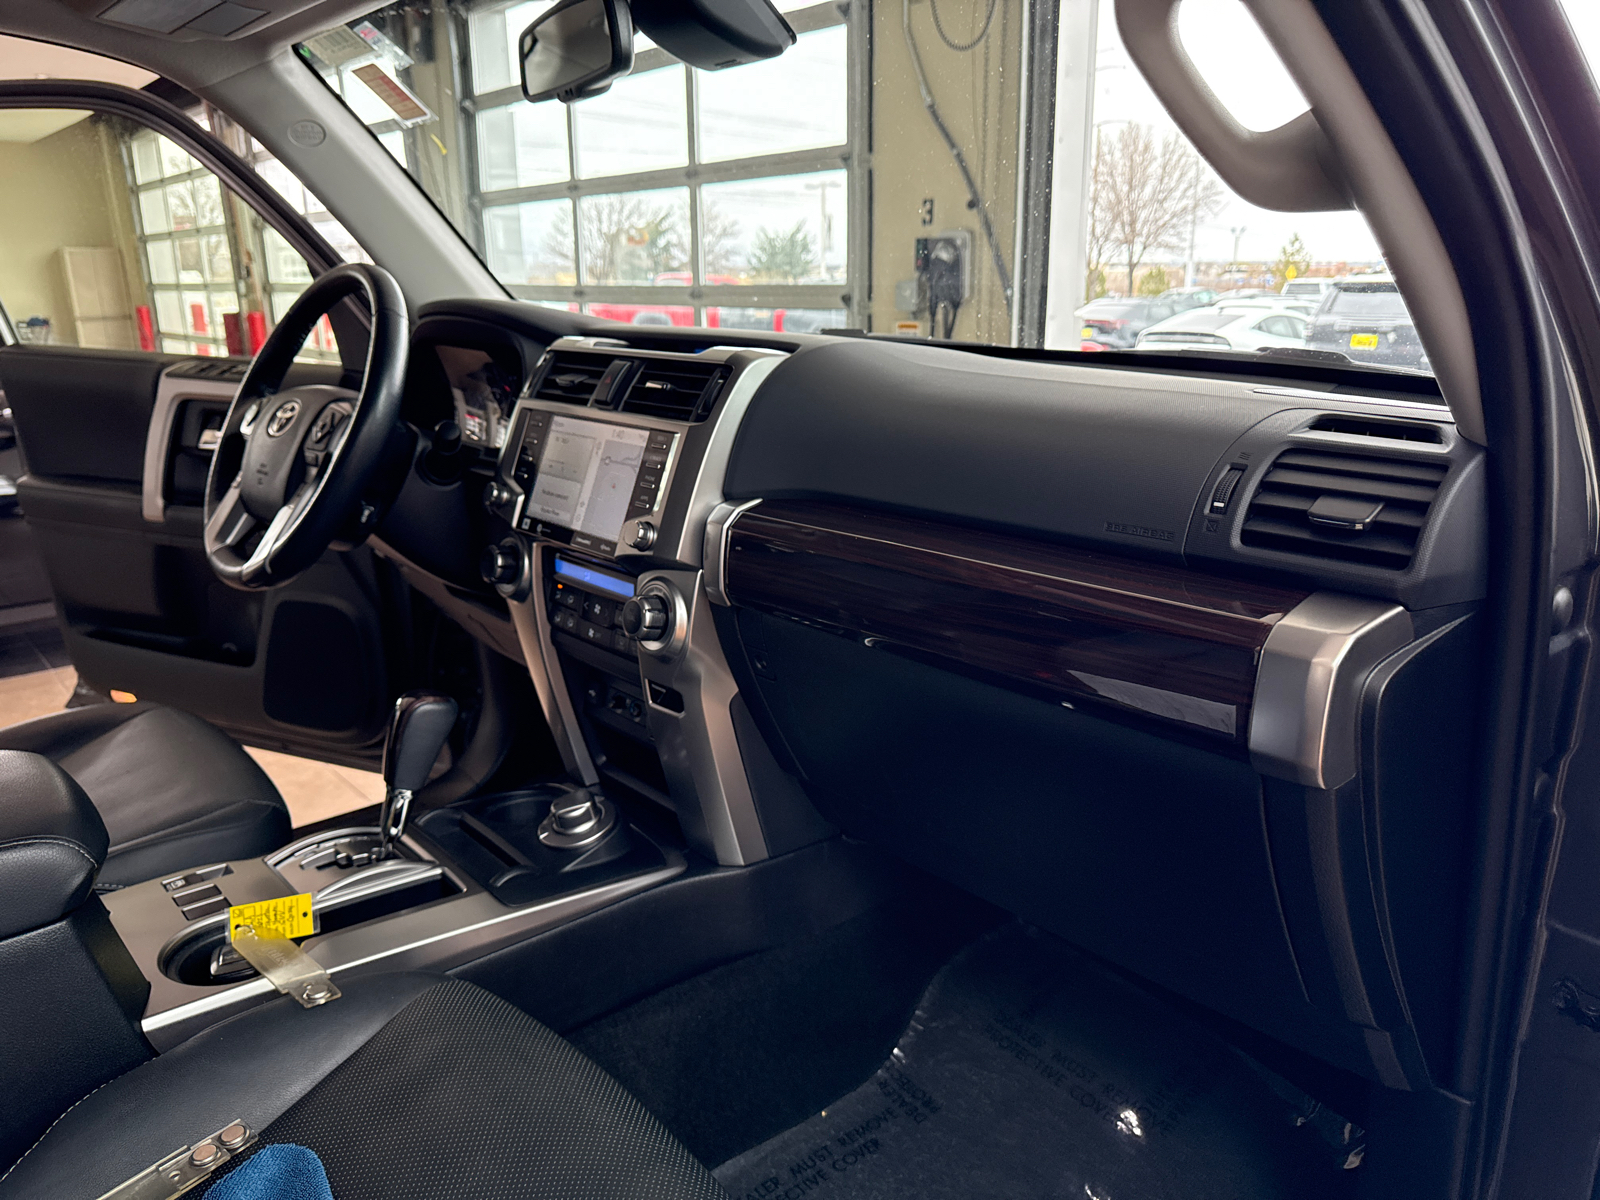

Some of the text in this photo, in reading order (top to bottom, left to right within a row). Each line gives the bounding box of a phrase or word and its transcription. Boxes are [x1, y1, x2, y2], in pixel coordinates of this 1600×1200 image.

[922, 198, 934, 226] 3
[1129, 526, 1175, 540] AIRBAG
[789, 1145, 833, 1180] MUST
[836, 1106, 899, 1148] REMOVE
[831, 1137, 881, 1172] COVER
